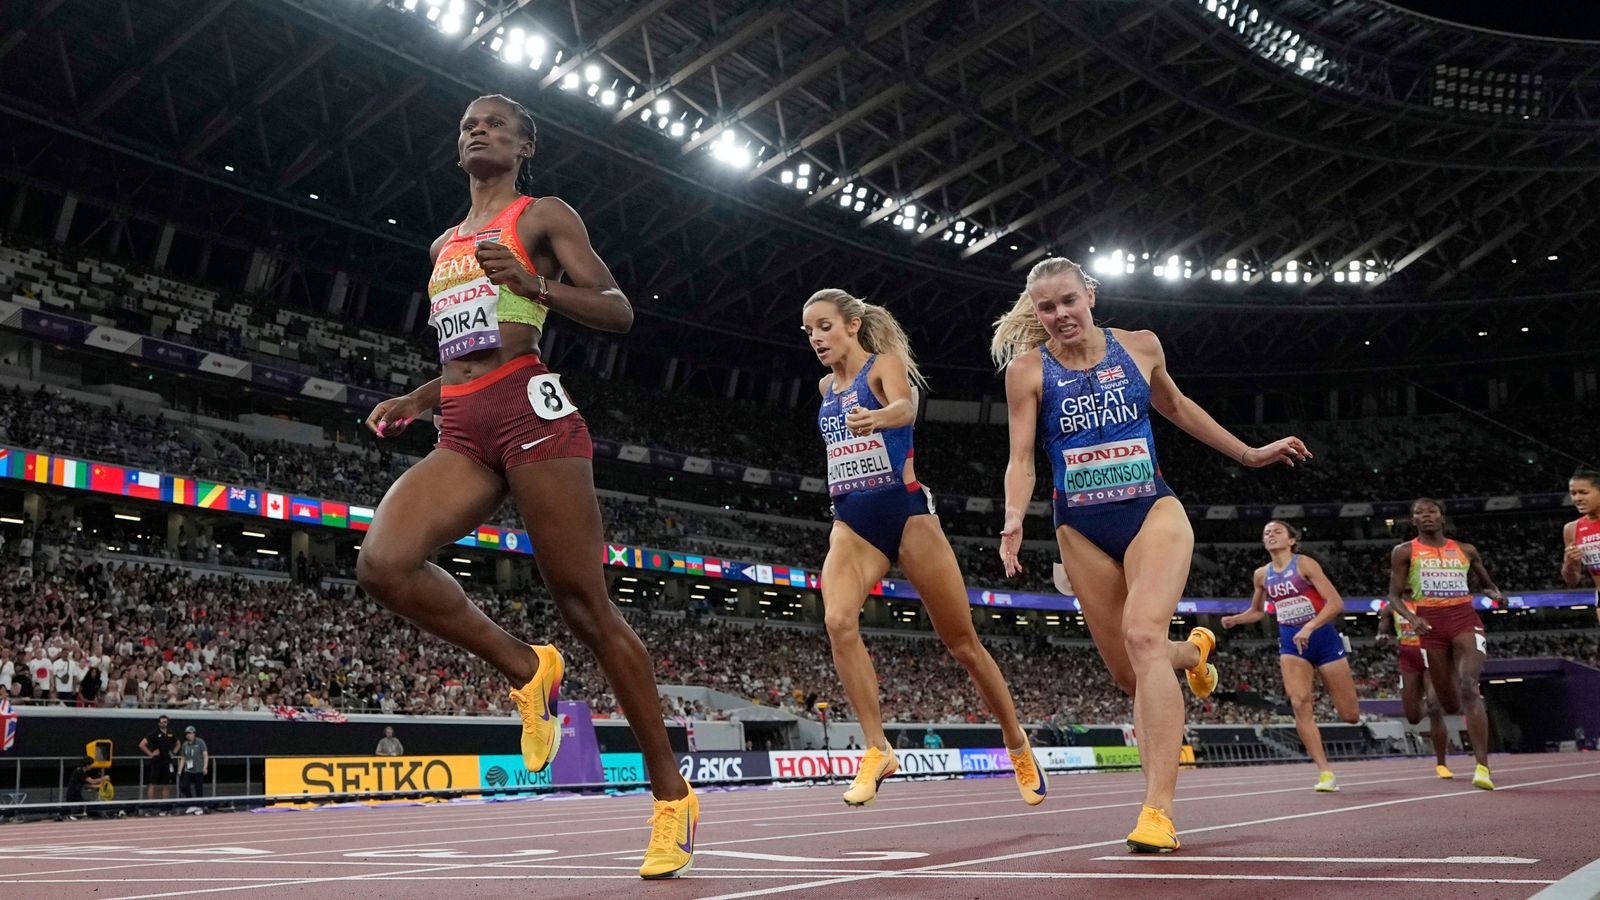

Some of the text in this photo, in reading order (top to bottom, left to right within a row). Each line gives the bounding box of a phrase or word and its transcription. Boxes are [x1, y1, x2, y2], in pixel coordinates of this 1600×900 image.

[430, 254, 480, 283] KENY
[539, 381, 563, 412] 8
[1061, 386, 1126, 415] GREAT
[820, 412, 848, 432] GRE
[1060, 402, 1138, 433] BRITAIN
[828, 440, 883, 460] HONDA
[1066, 444, 1148, 465] HONDA
[860, 455, 889, 475] BELL
[1067, 462, 1151, 490] HODGKINSON
[1419, 557, 1464, 569] KENYA
[1266, 581, 1299, 599] USA
[697, 757, 743, 782] asics
[970, 754, 1000, 772] TDK
[301, 759, 453, 793] SEIKO
[514, 768, 552, 785] WORL
